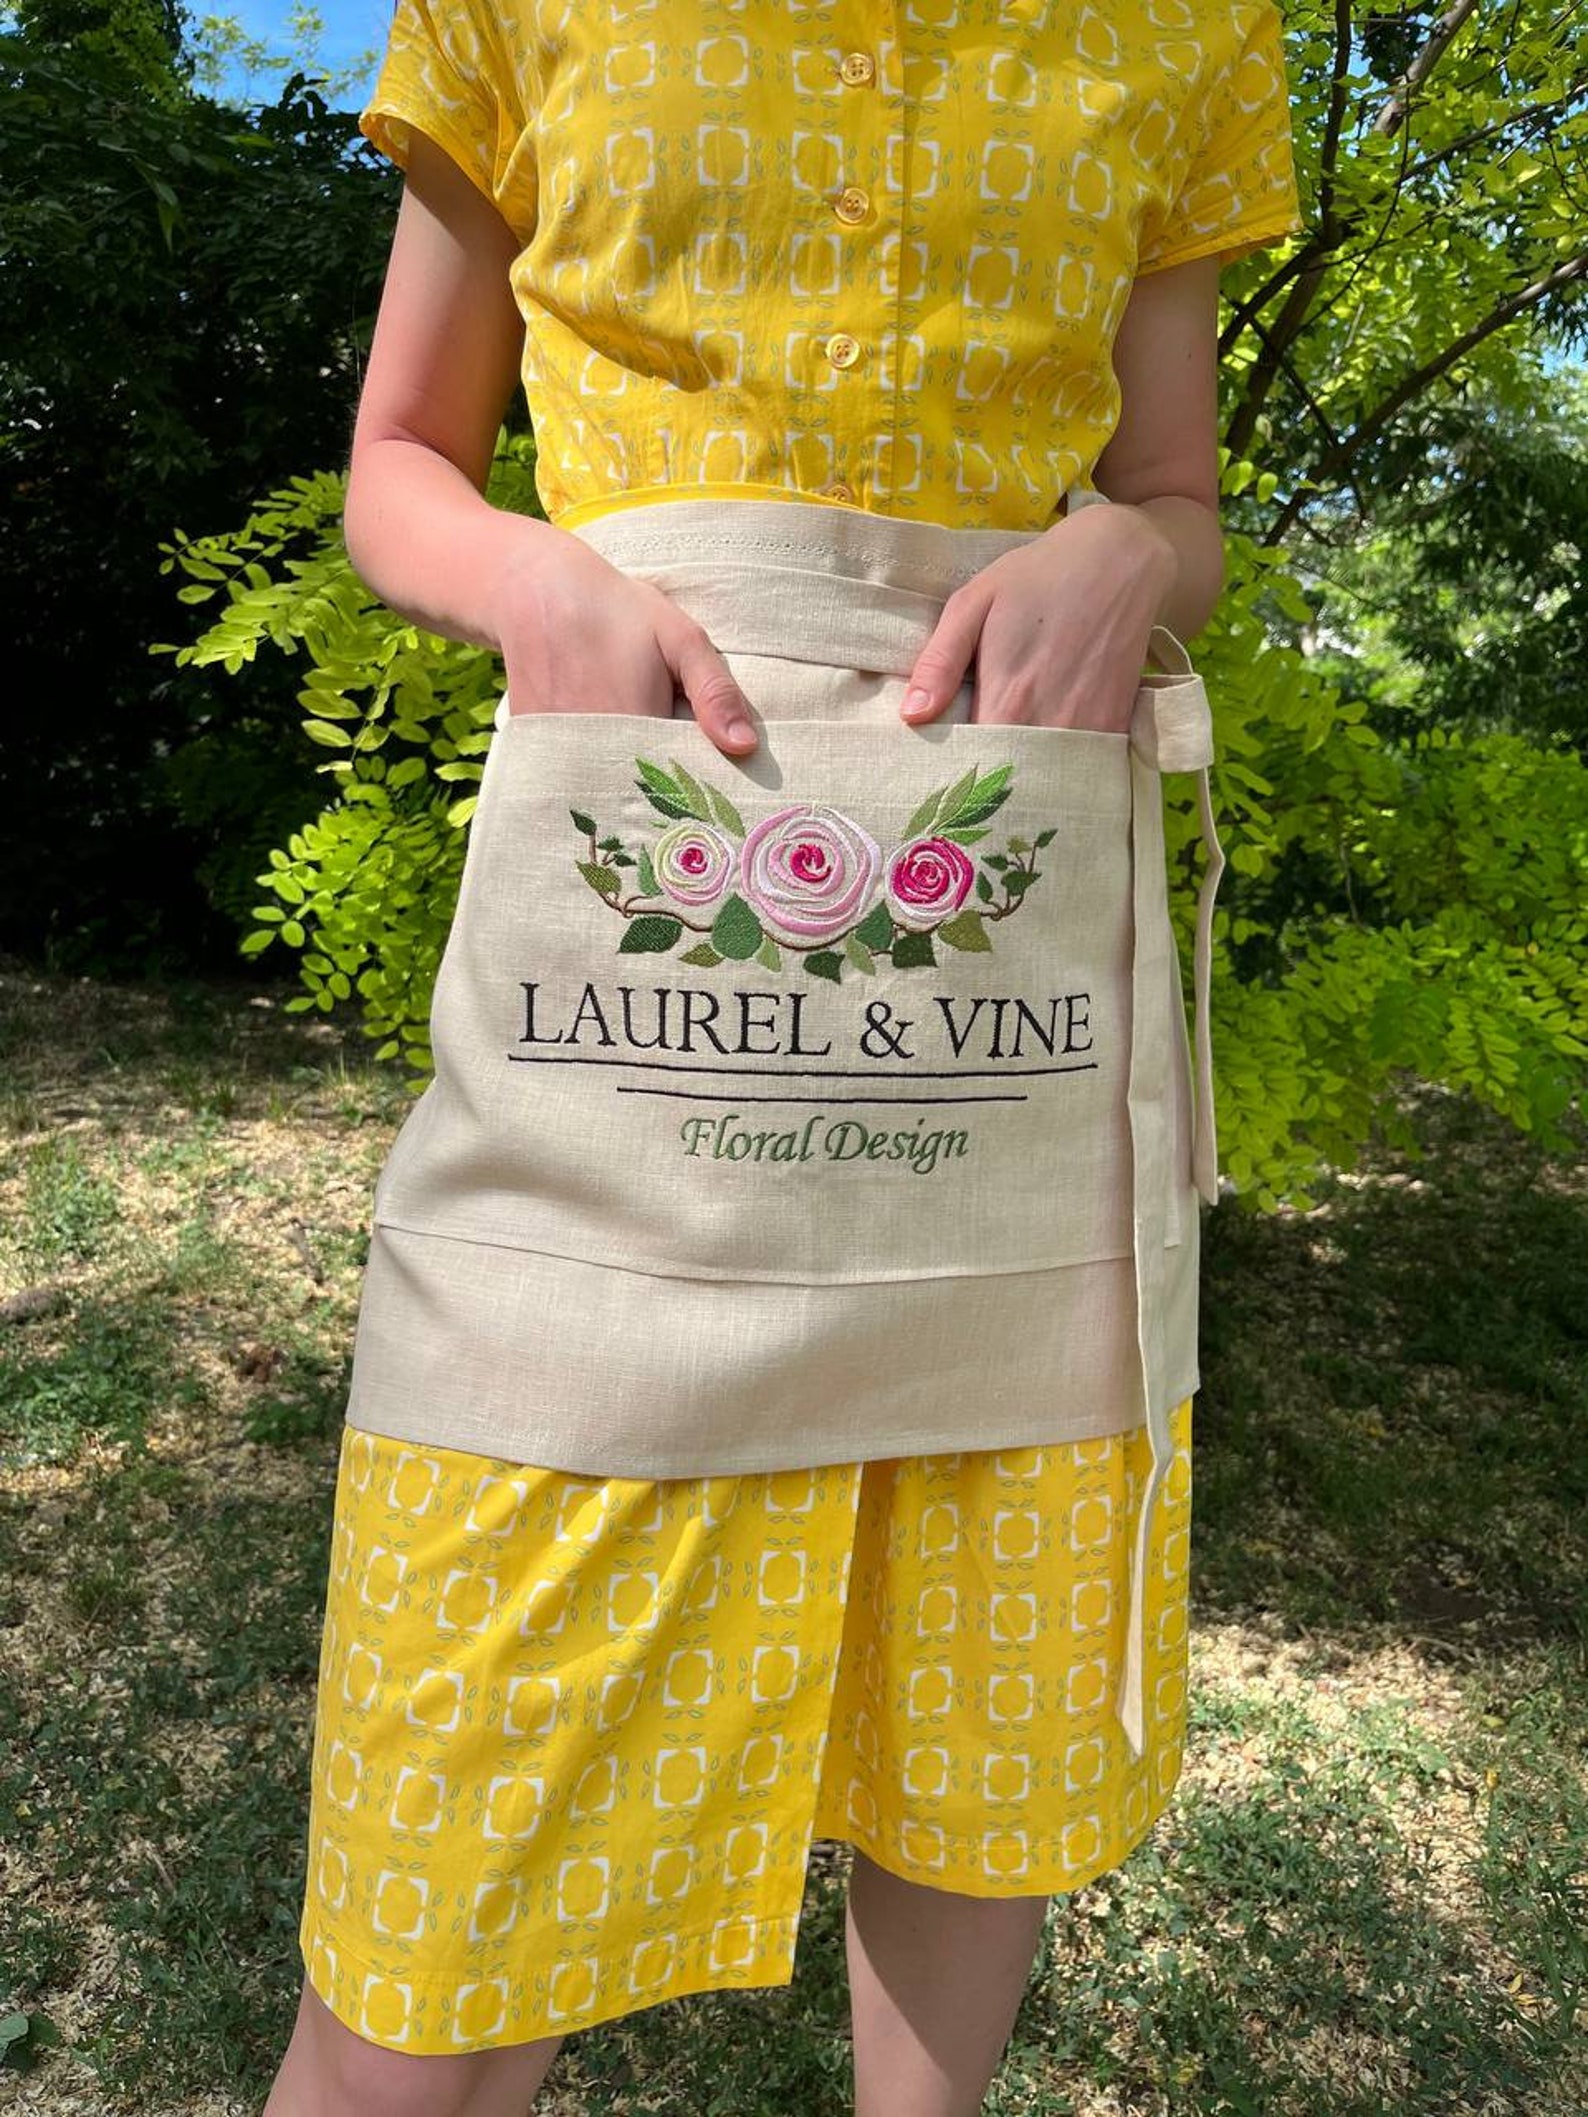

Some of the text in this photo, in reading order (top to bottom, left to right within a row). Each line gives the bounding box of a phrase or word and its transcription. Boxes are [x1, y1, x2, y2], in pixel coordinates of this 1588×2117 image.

[518, 982, 1094, 1061] LAUREL & VINE
[680, 1114, 969, 1175] Floral Design
